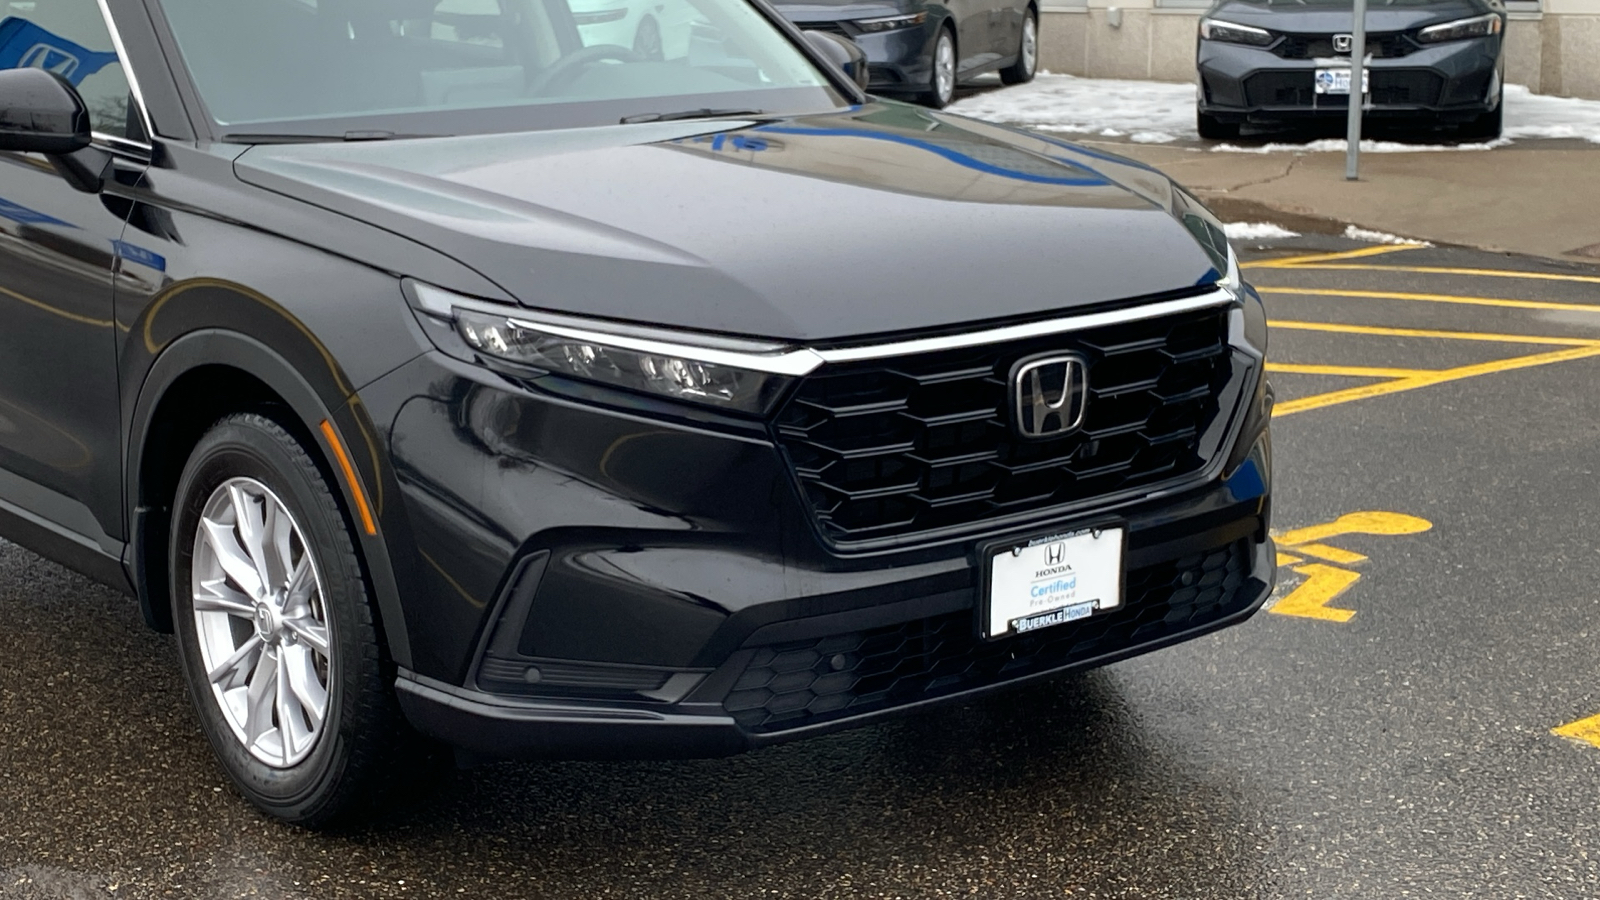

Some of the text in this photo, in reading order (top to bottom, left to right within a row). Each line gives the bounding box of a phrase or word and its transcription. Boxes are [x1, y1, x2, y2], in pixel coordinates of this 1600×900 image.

[1035, 564, 1072, 578] HONDA
[1030, 577, 1077, 598] Certified
[1029, 591, 1076, 607] Pre-Owned
[1019, 611, 1064, 631] BUERKLE
[1064, 606, 1090, 620] HONDA
